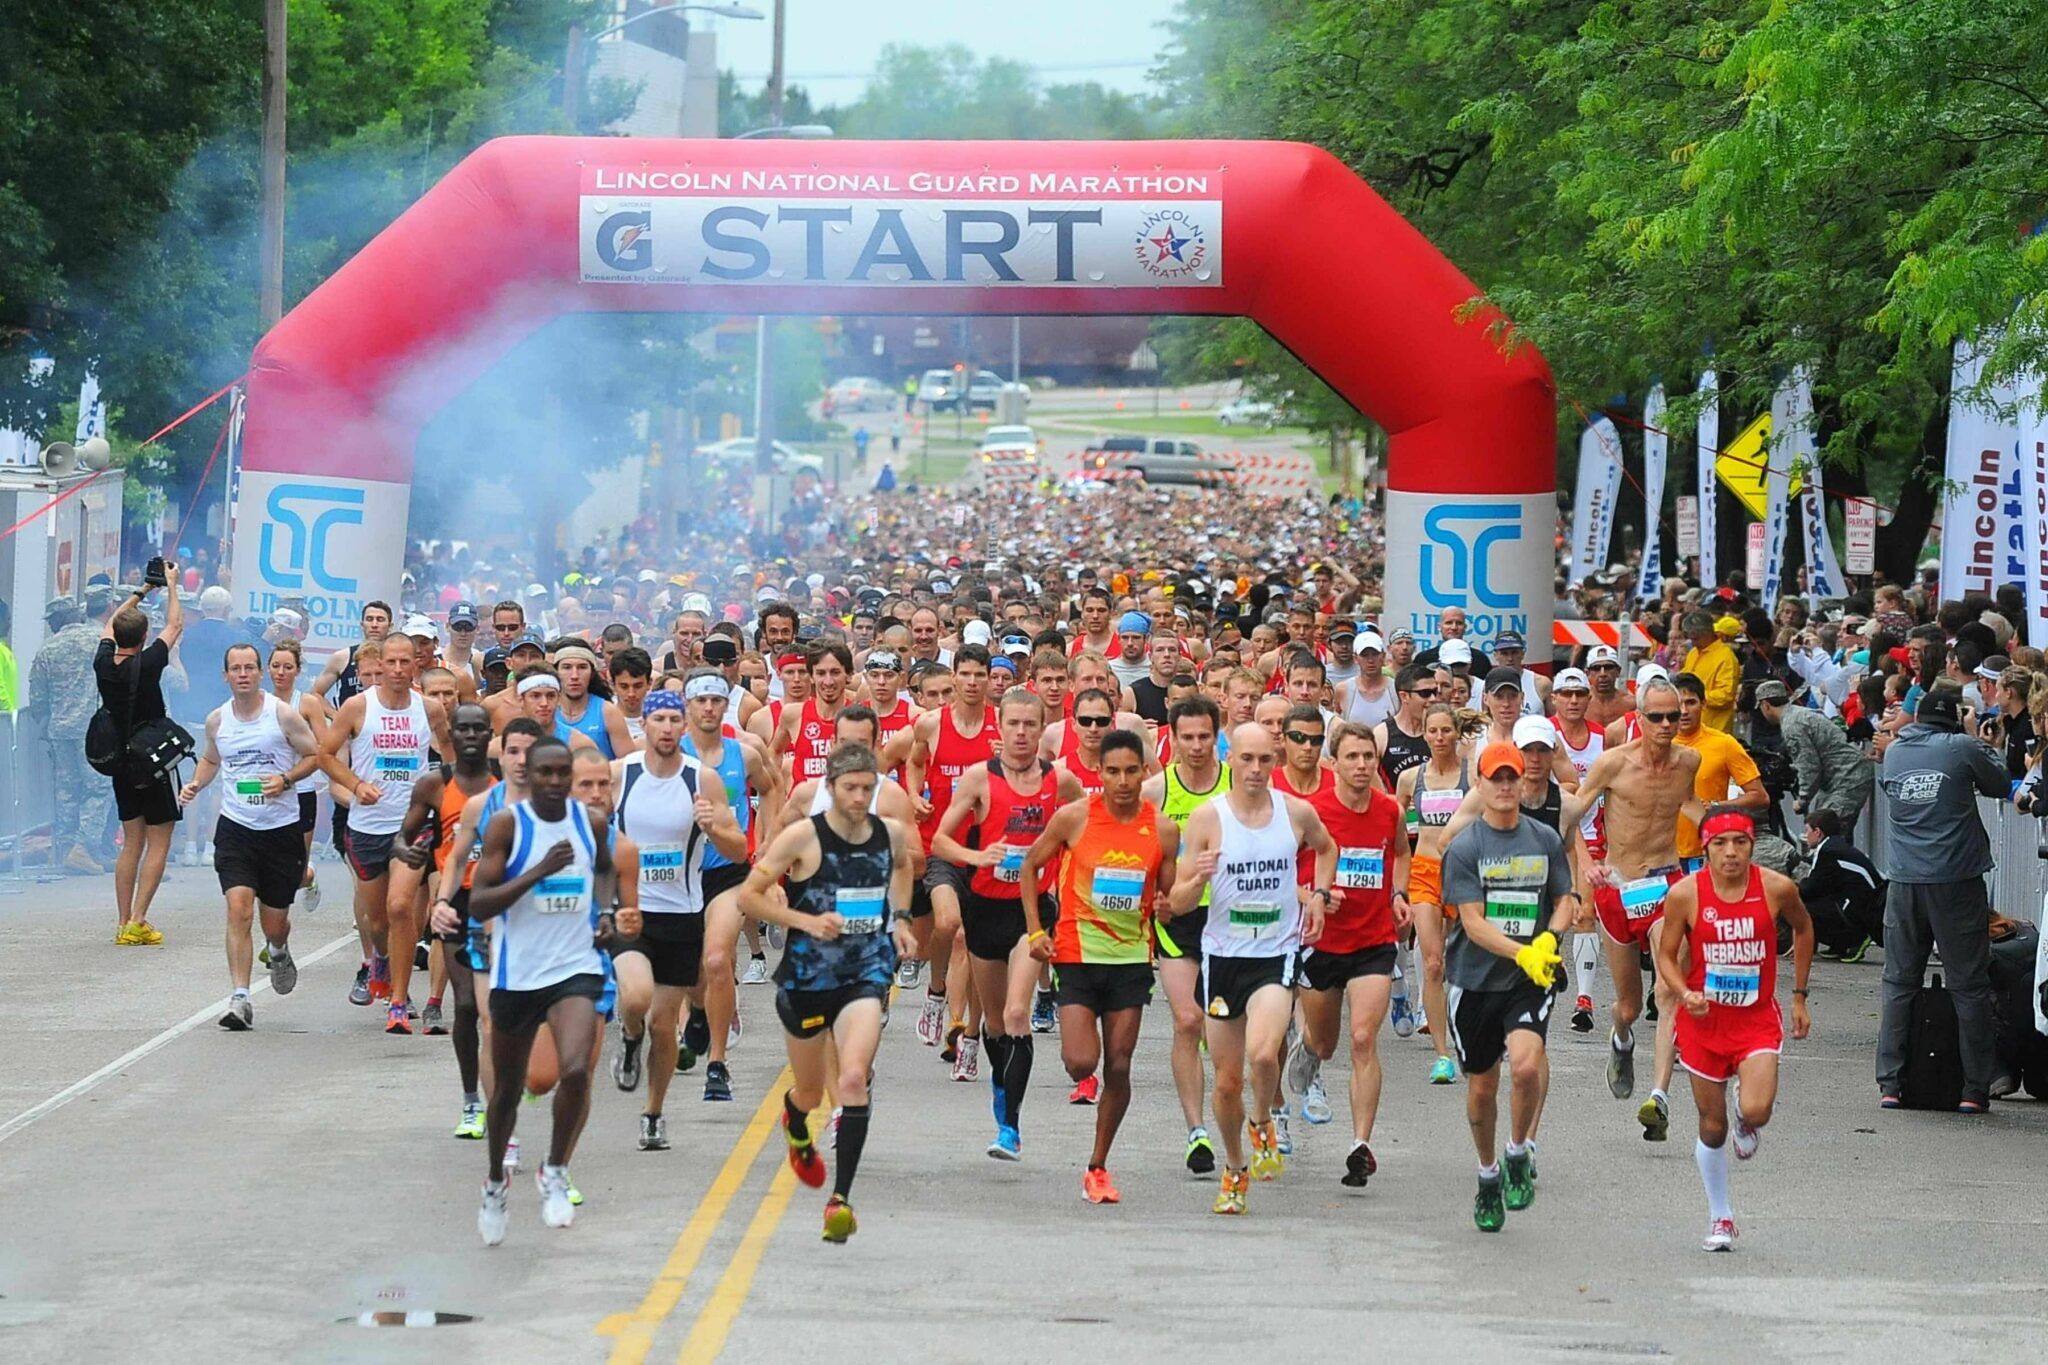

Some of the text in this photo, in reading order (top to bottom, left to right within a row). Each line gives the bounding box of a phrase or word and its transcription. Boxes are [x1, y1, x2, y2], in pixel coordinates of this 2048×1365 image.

[1137, 210, 1203, 238] LINCOLN
[700, 205, 1103, 282] START
[1135, 246, 1206, 279] MARATHON
[584, 274, 632, 282] Presented
[634, 275, 645, 283] by
[1848, 499, 1861, 515] NO
[1583, 488, 1602, 565] Lincoln
[1848, 518, 1873, 528] PARKING
[1751, 525, 1765, 538] NO
[381, 716, 410, 731] TEAM
[373, 734, 418, 749] NEBRASKA
[811, 740, 832, 756] TEA
[940, 764, 960, 775] TEAM
[1393, 755, 1419, 775] RIVER
[383, 771, 409, 782] 2060
[1904, 773, 1944, 785] ACTION
[1902, 783, 1941, 791] SPORTS
[643, 854, 673, 866] Mark
[1227, 859, 1289, 875] NATIONAL
[1347, 859, 1377, 872] Bryce
[644, 868, 675, 881] 1309
[1346, 874, 1375, 887] 1294
[1237, 878, 1280, 891] GUARD
[546, 897, 579, 911] 1447
[1101, 896, 1133, 910] 4650
[1634, 902, 1658, 917] 463
[1253, 927, 1258, 939] 1
[1503, 921, 1520, 934] 43
[1714, 918, 1755, 941] TEAM
[1703, 940, 1766, 964] NEBRASKA
[1715, 976, 1750, 990] Ricky
[1715, 992, 1748, 1005] 1287
